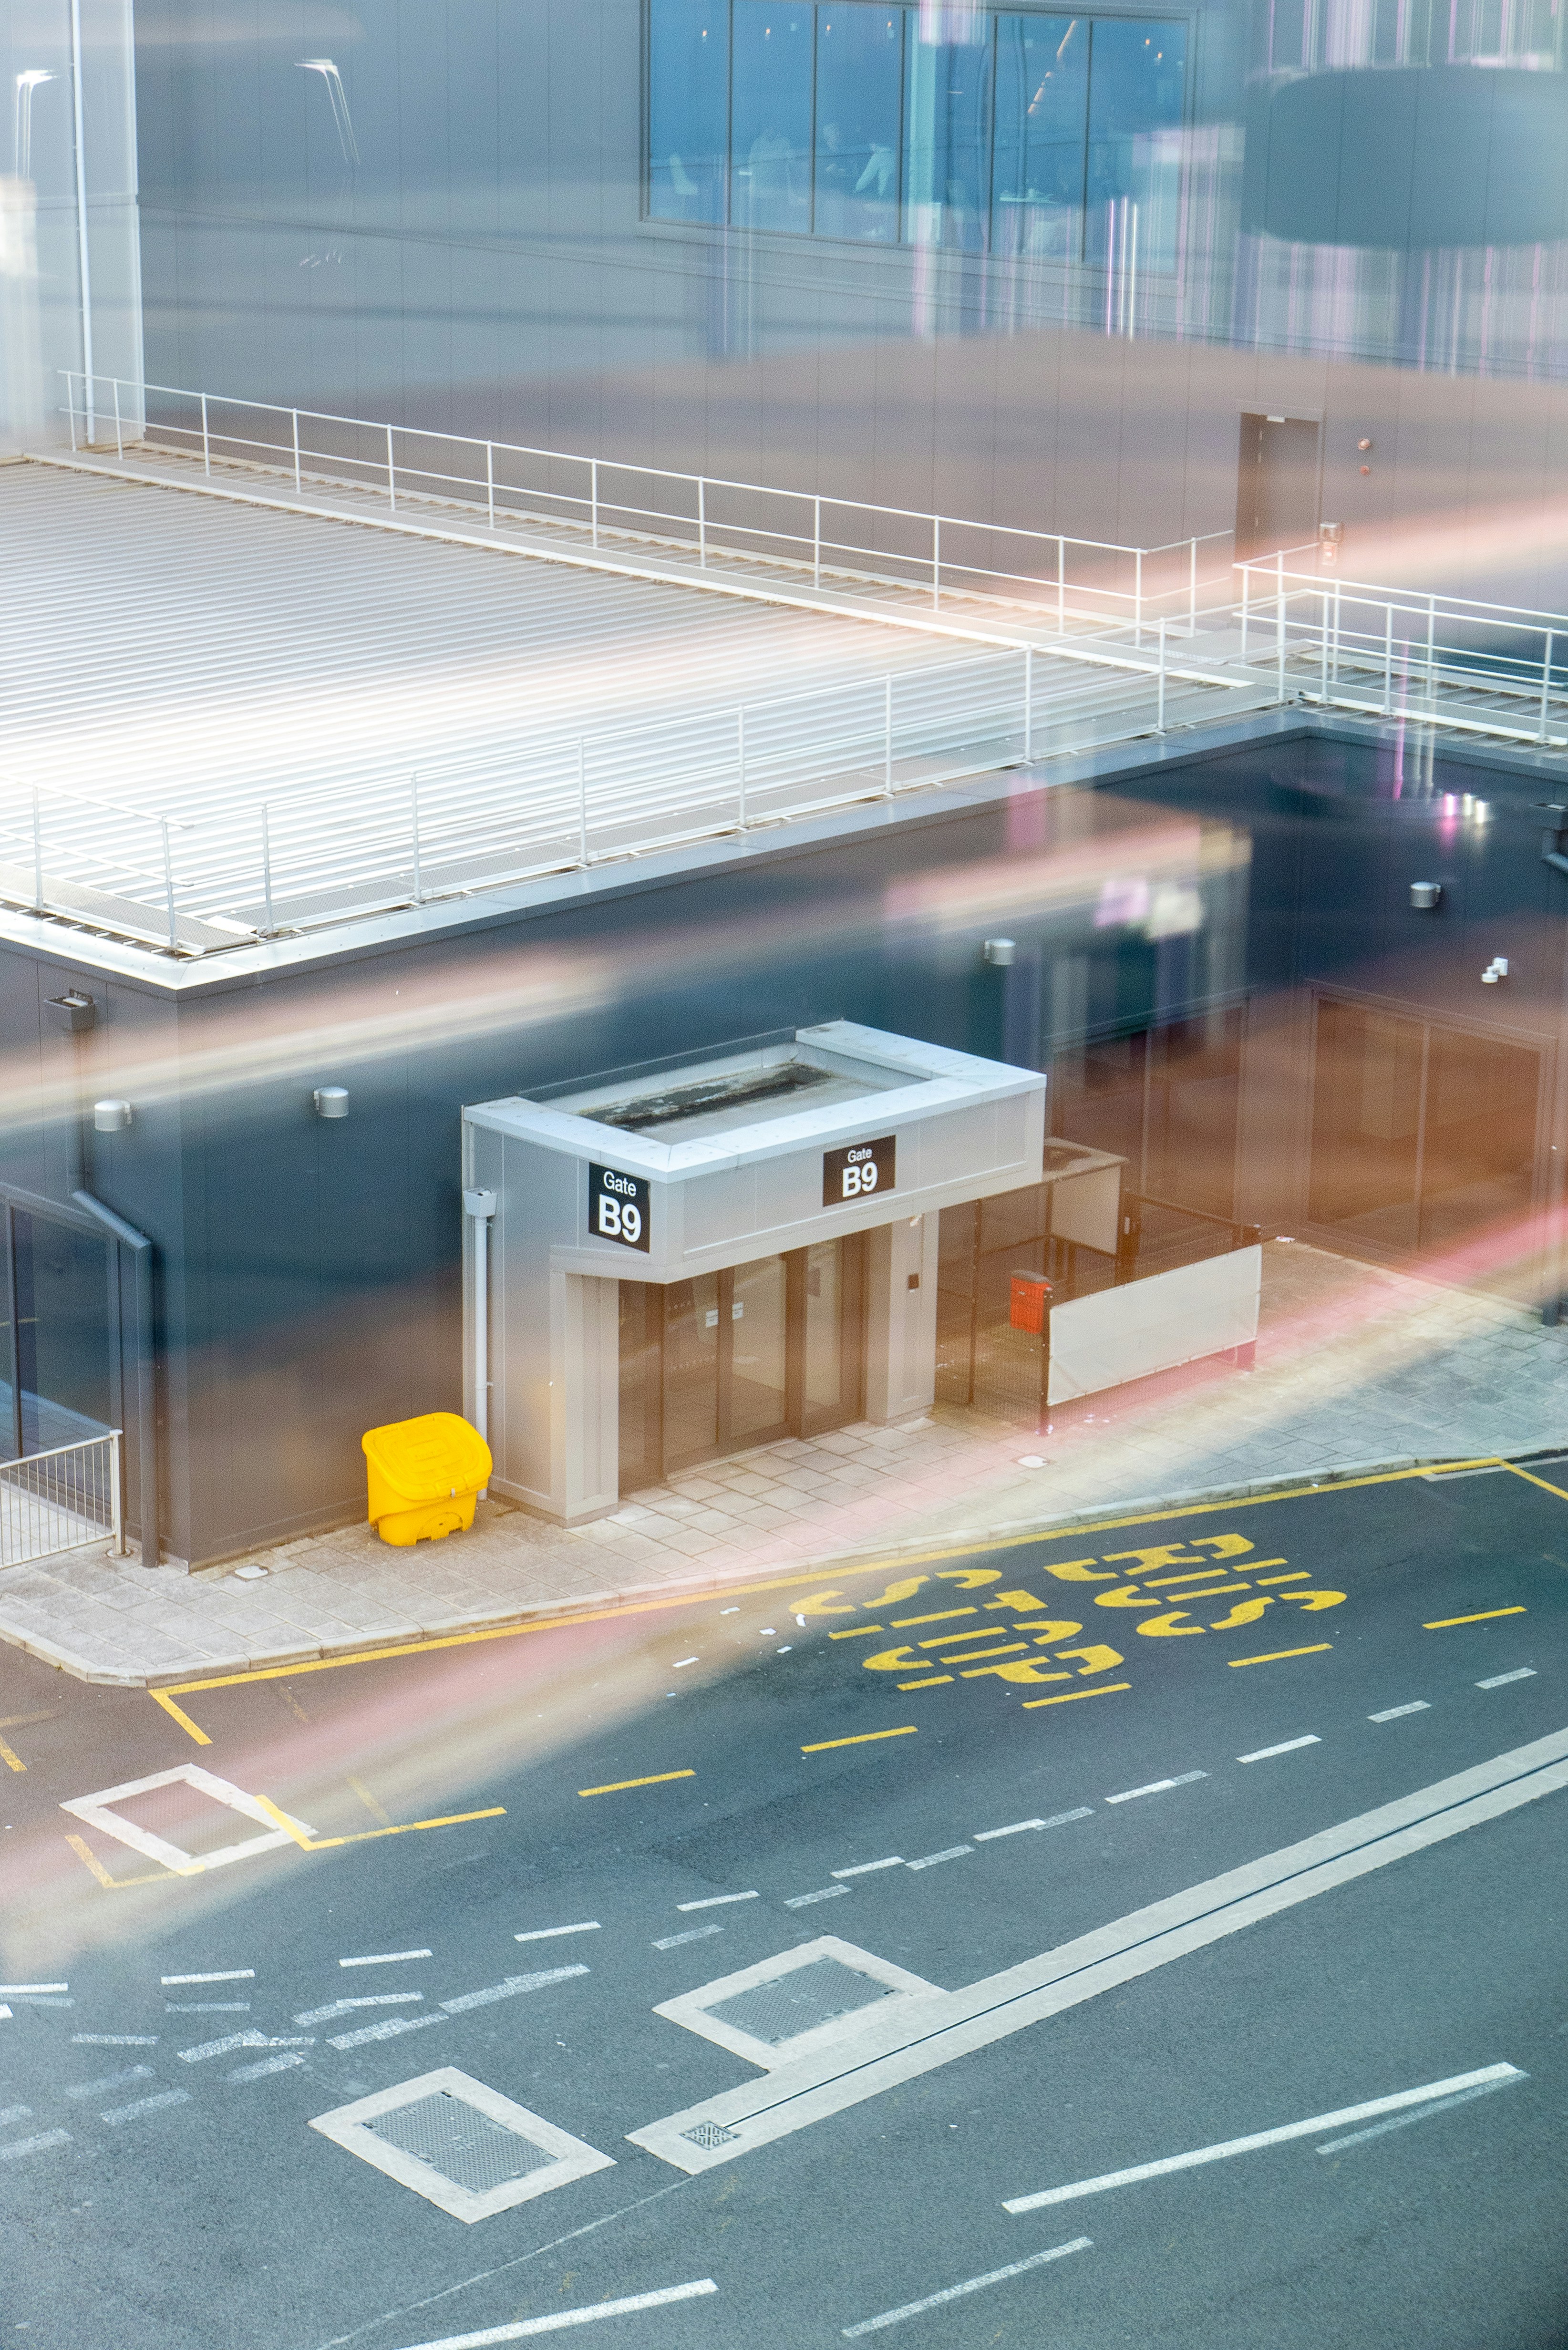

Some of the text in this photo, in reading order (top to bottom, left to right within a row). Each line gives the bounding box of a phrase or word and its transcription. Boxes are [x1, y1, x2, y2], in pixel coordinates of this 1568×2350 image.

[847, 1148, 873, 1163] Gate
[603, 1171, 637, 1197] Gate
[842, 1162, 878, 1197] B9
[599, 1194, 641, 1242] B9
[1044, 1534, 1347, 1636] BUS
[788, 1568, 1124, 1691] STOP
